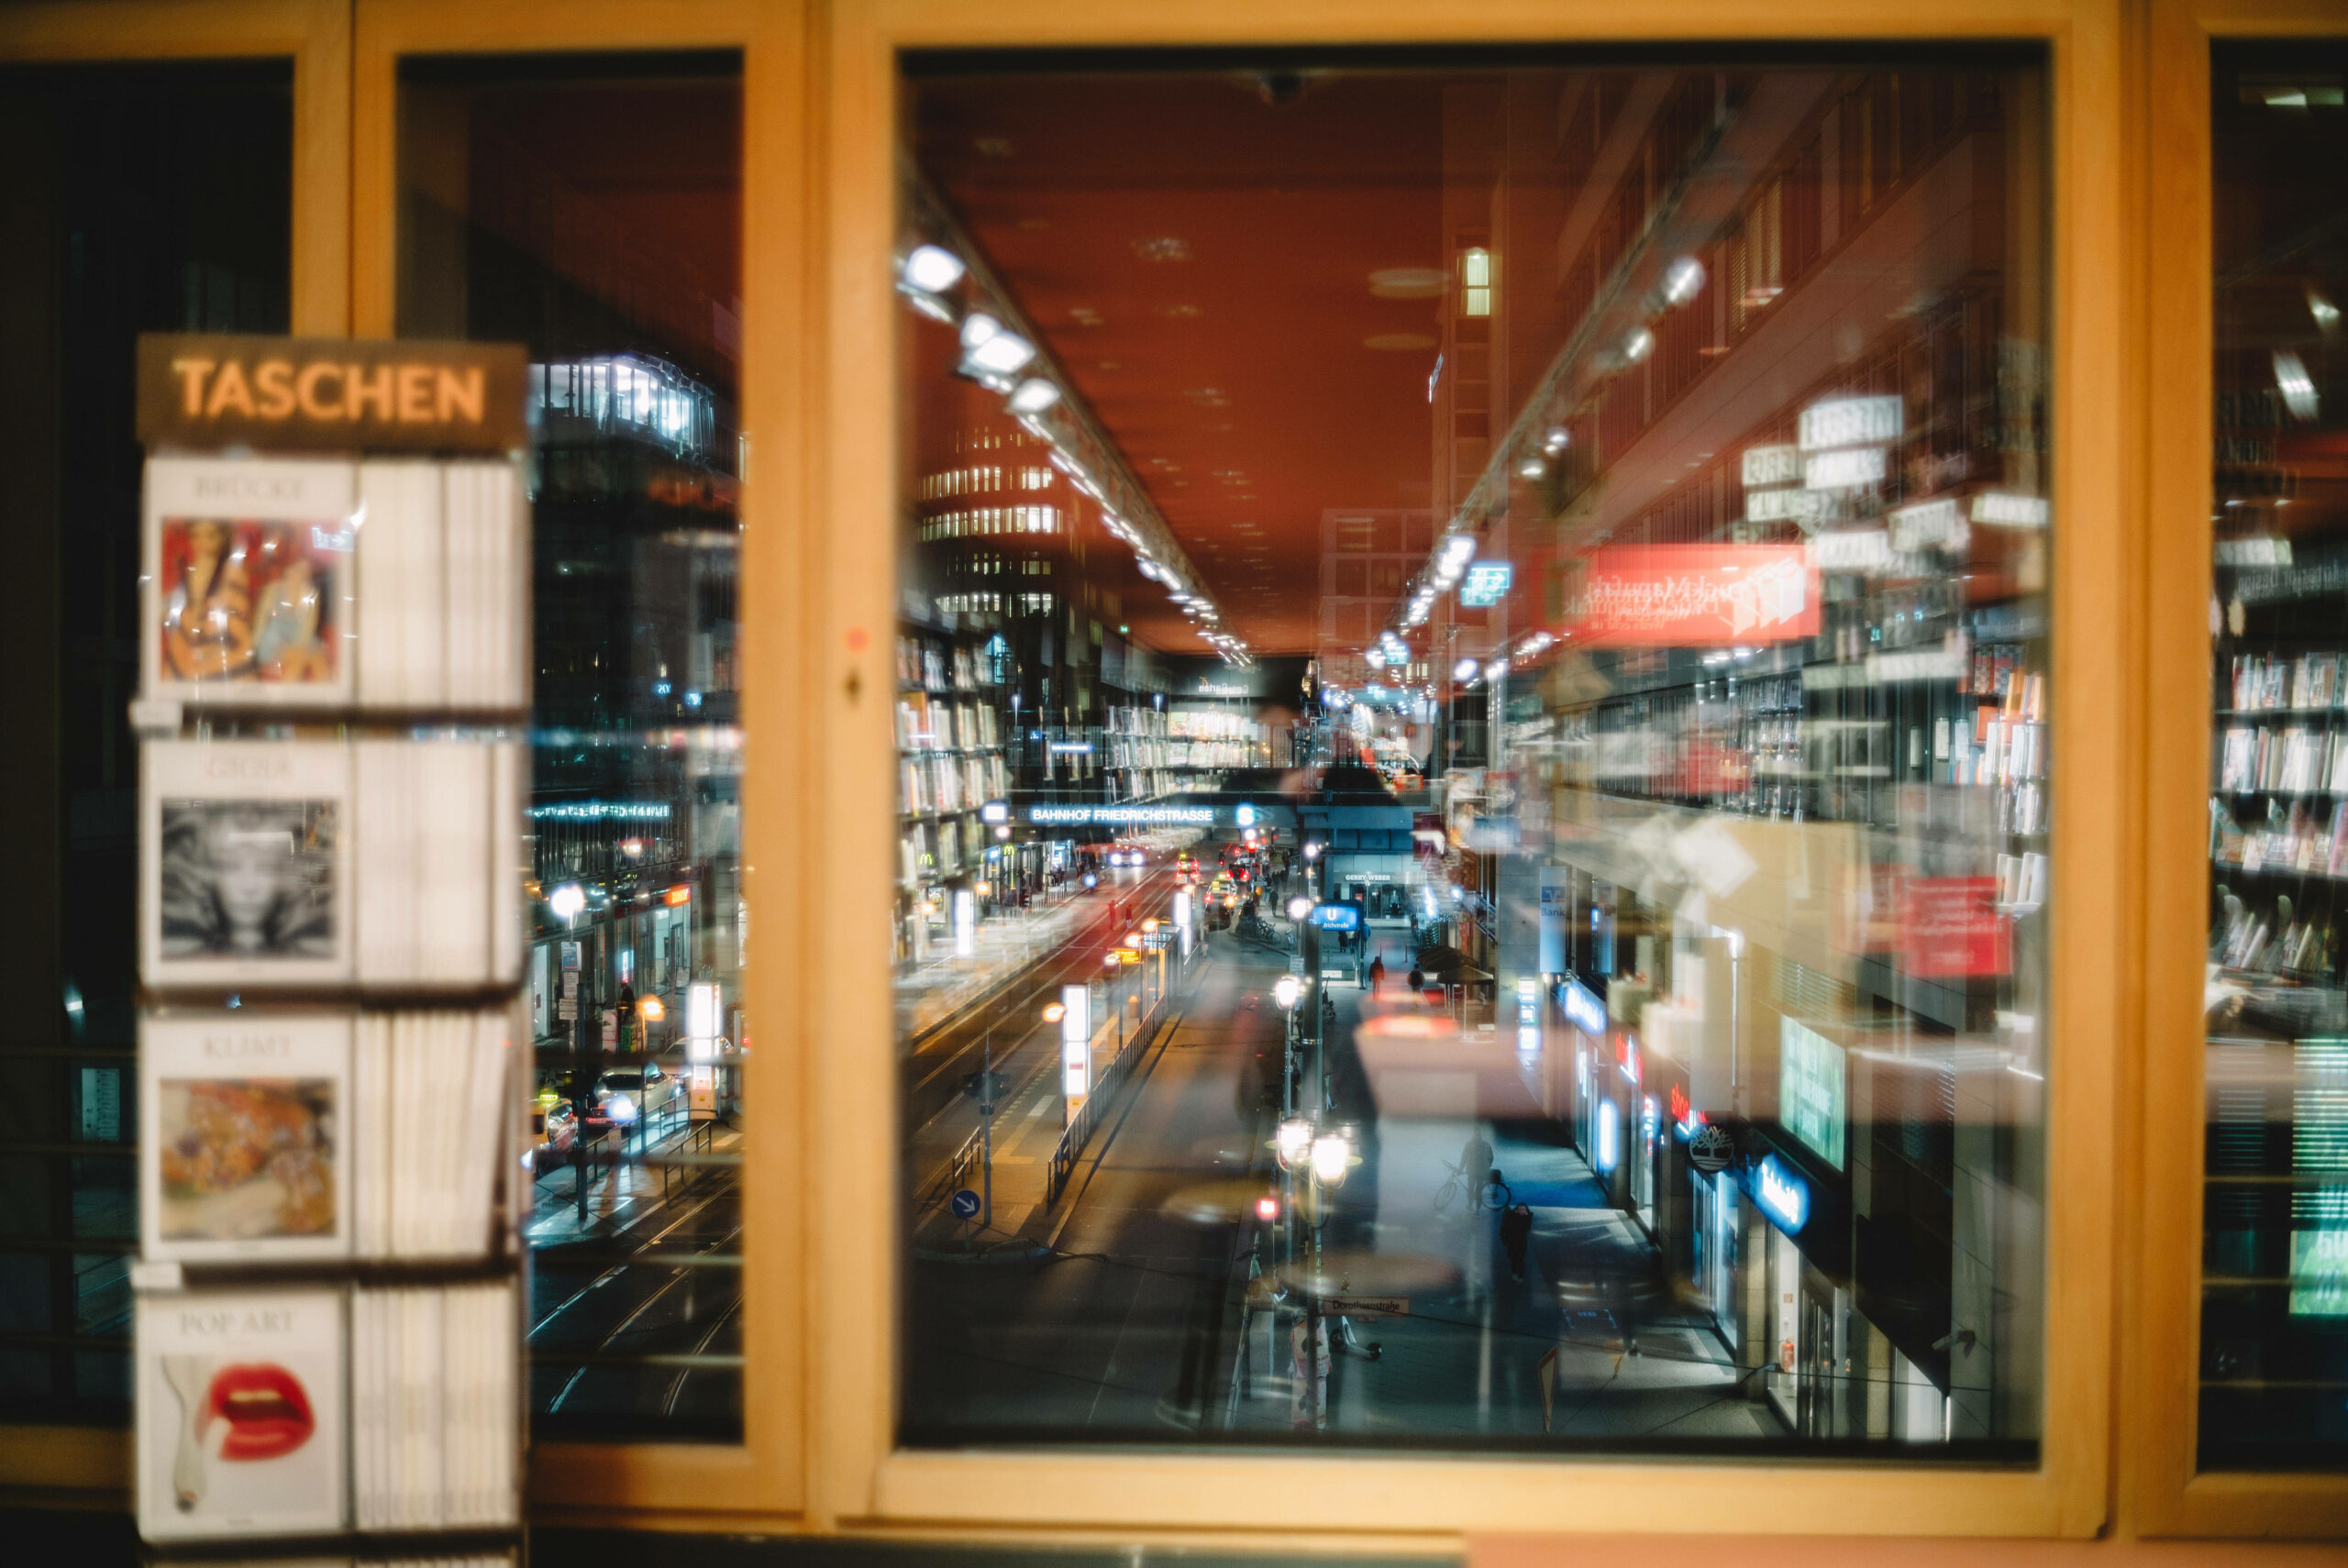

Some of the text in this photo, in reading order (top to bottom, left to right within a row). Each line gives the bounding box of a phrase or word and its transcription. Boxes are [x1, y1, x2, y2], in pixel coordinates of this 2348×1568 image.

[174, 359, 486, 425] TASCHEN
[1033, 809, 1213, 822] BAHNHOF FRIEDRICHSTRASSE
[1238, 803, 1255, 825] S
[1326, 908, 1337, 921] U
[1541, 908, 1566, 917] Bank
[1333, 1300, 1401, 1311] Dorotheenstraße
[183, 1310, 294, 1336] POP ART
